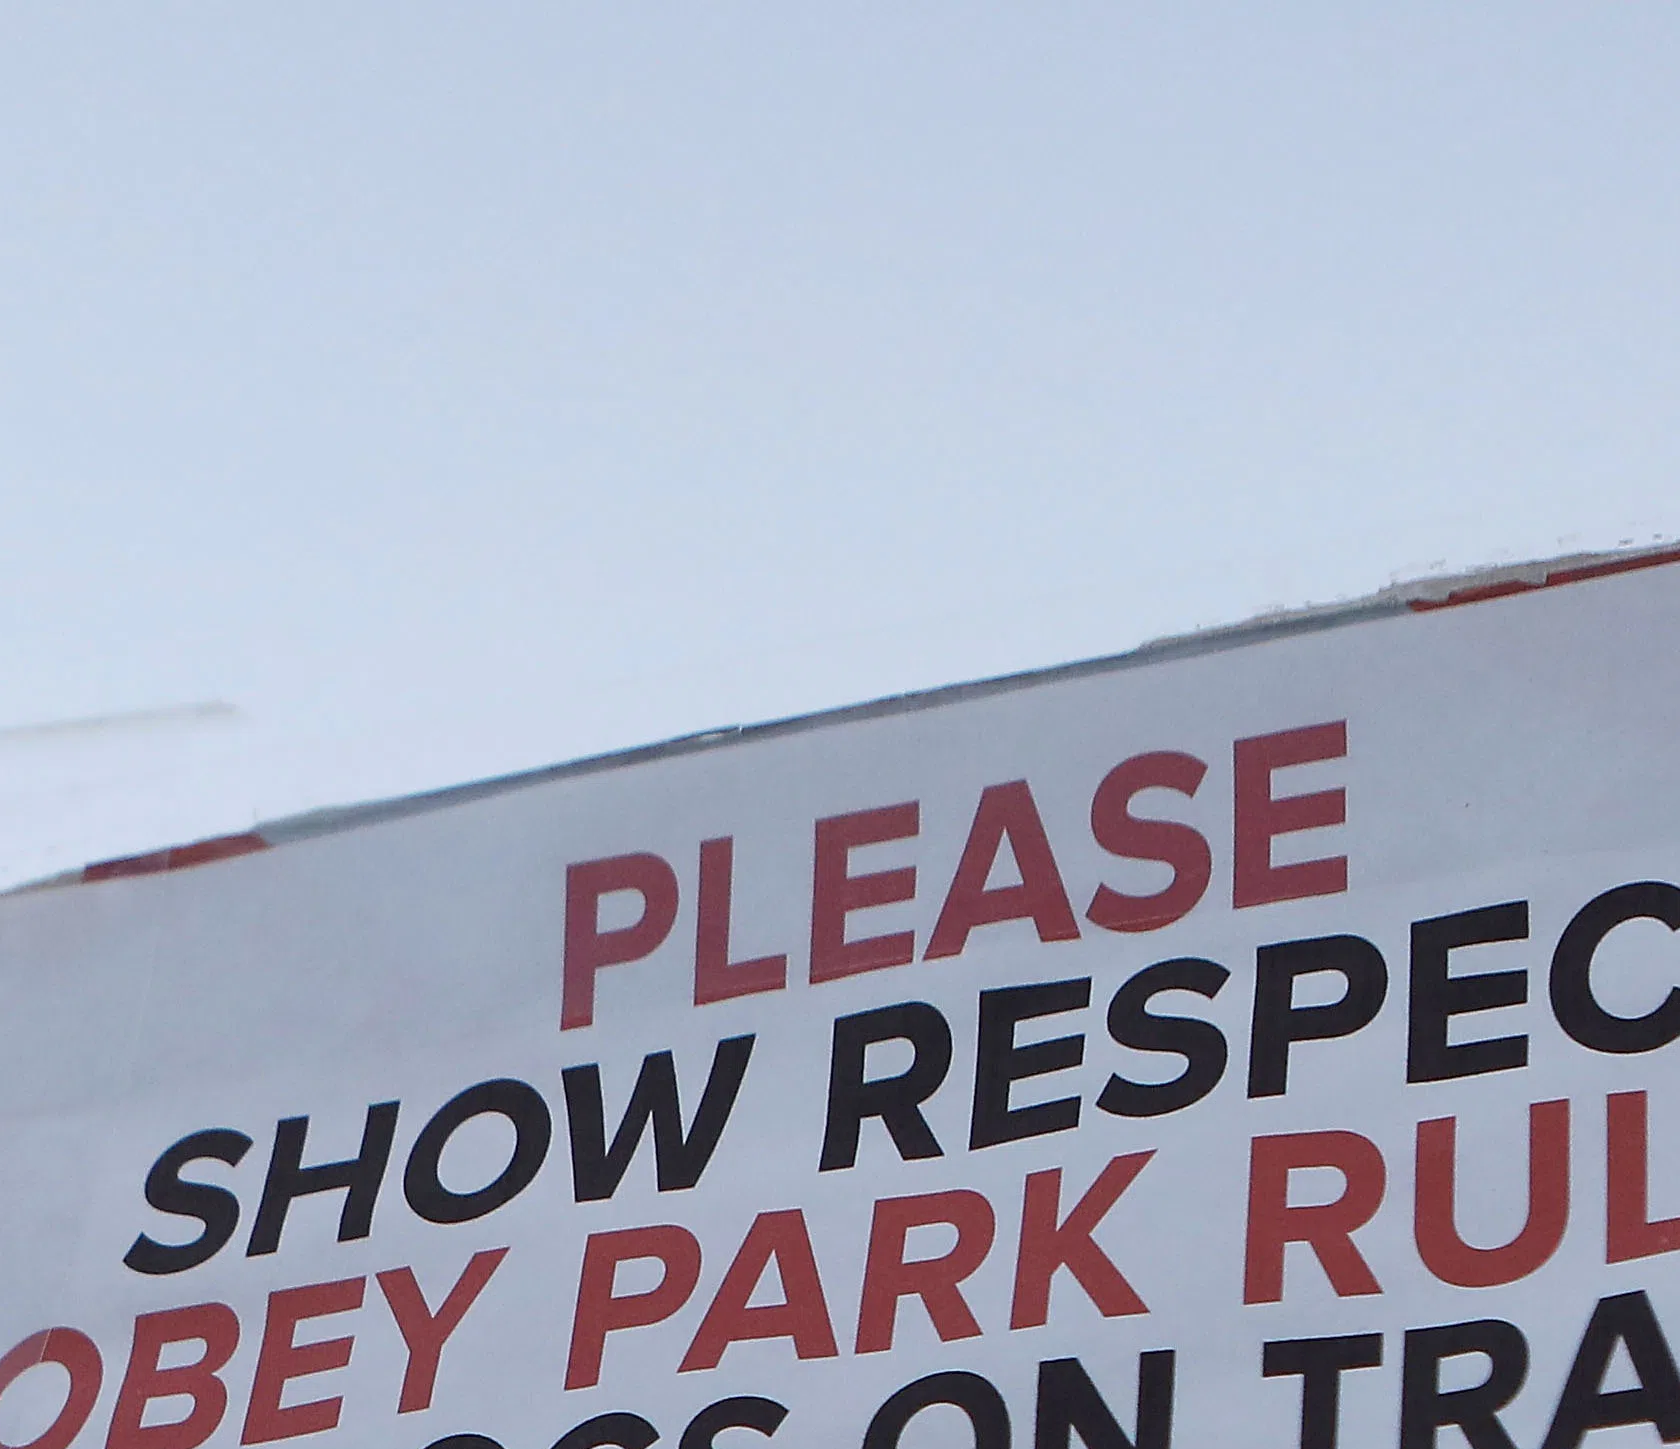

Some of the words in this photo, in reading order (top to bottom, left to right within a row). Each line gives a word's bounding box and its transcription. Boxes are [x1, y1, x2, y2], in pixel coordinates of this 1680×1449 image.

[558, 722, 1349, 1030] PLEASE
[123, 1034, 757, 1275] SHOW
[564, 1152, 1153, 1391] PARK
